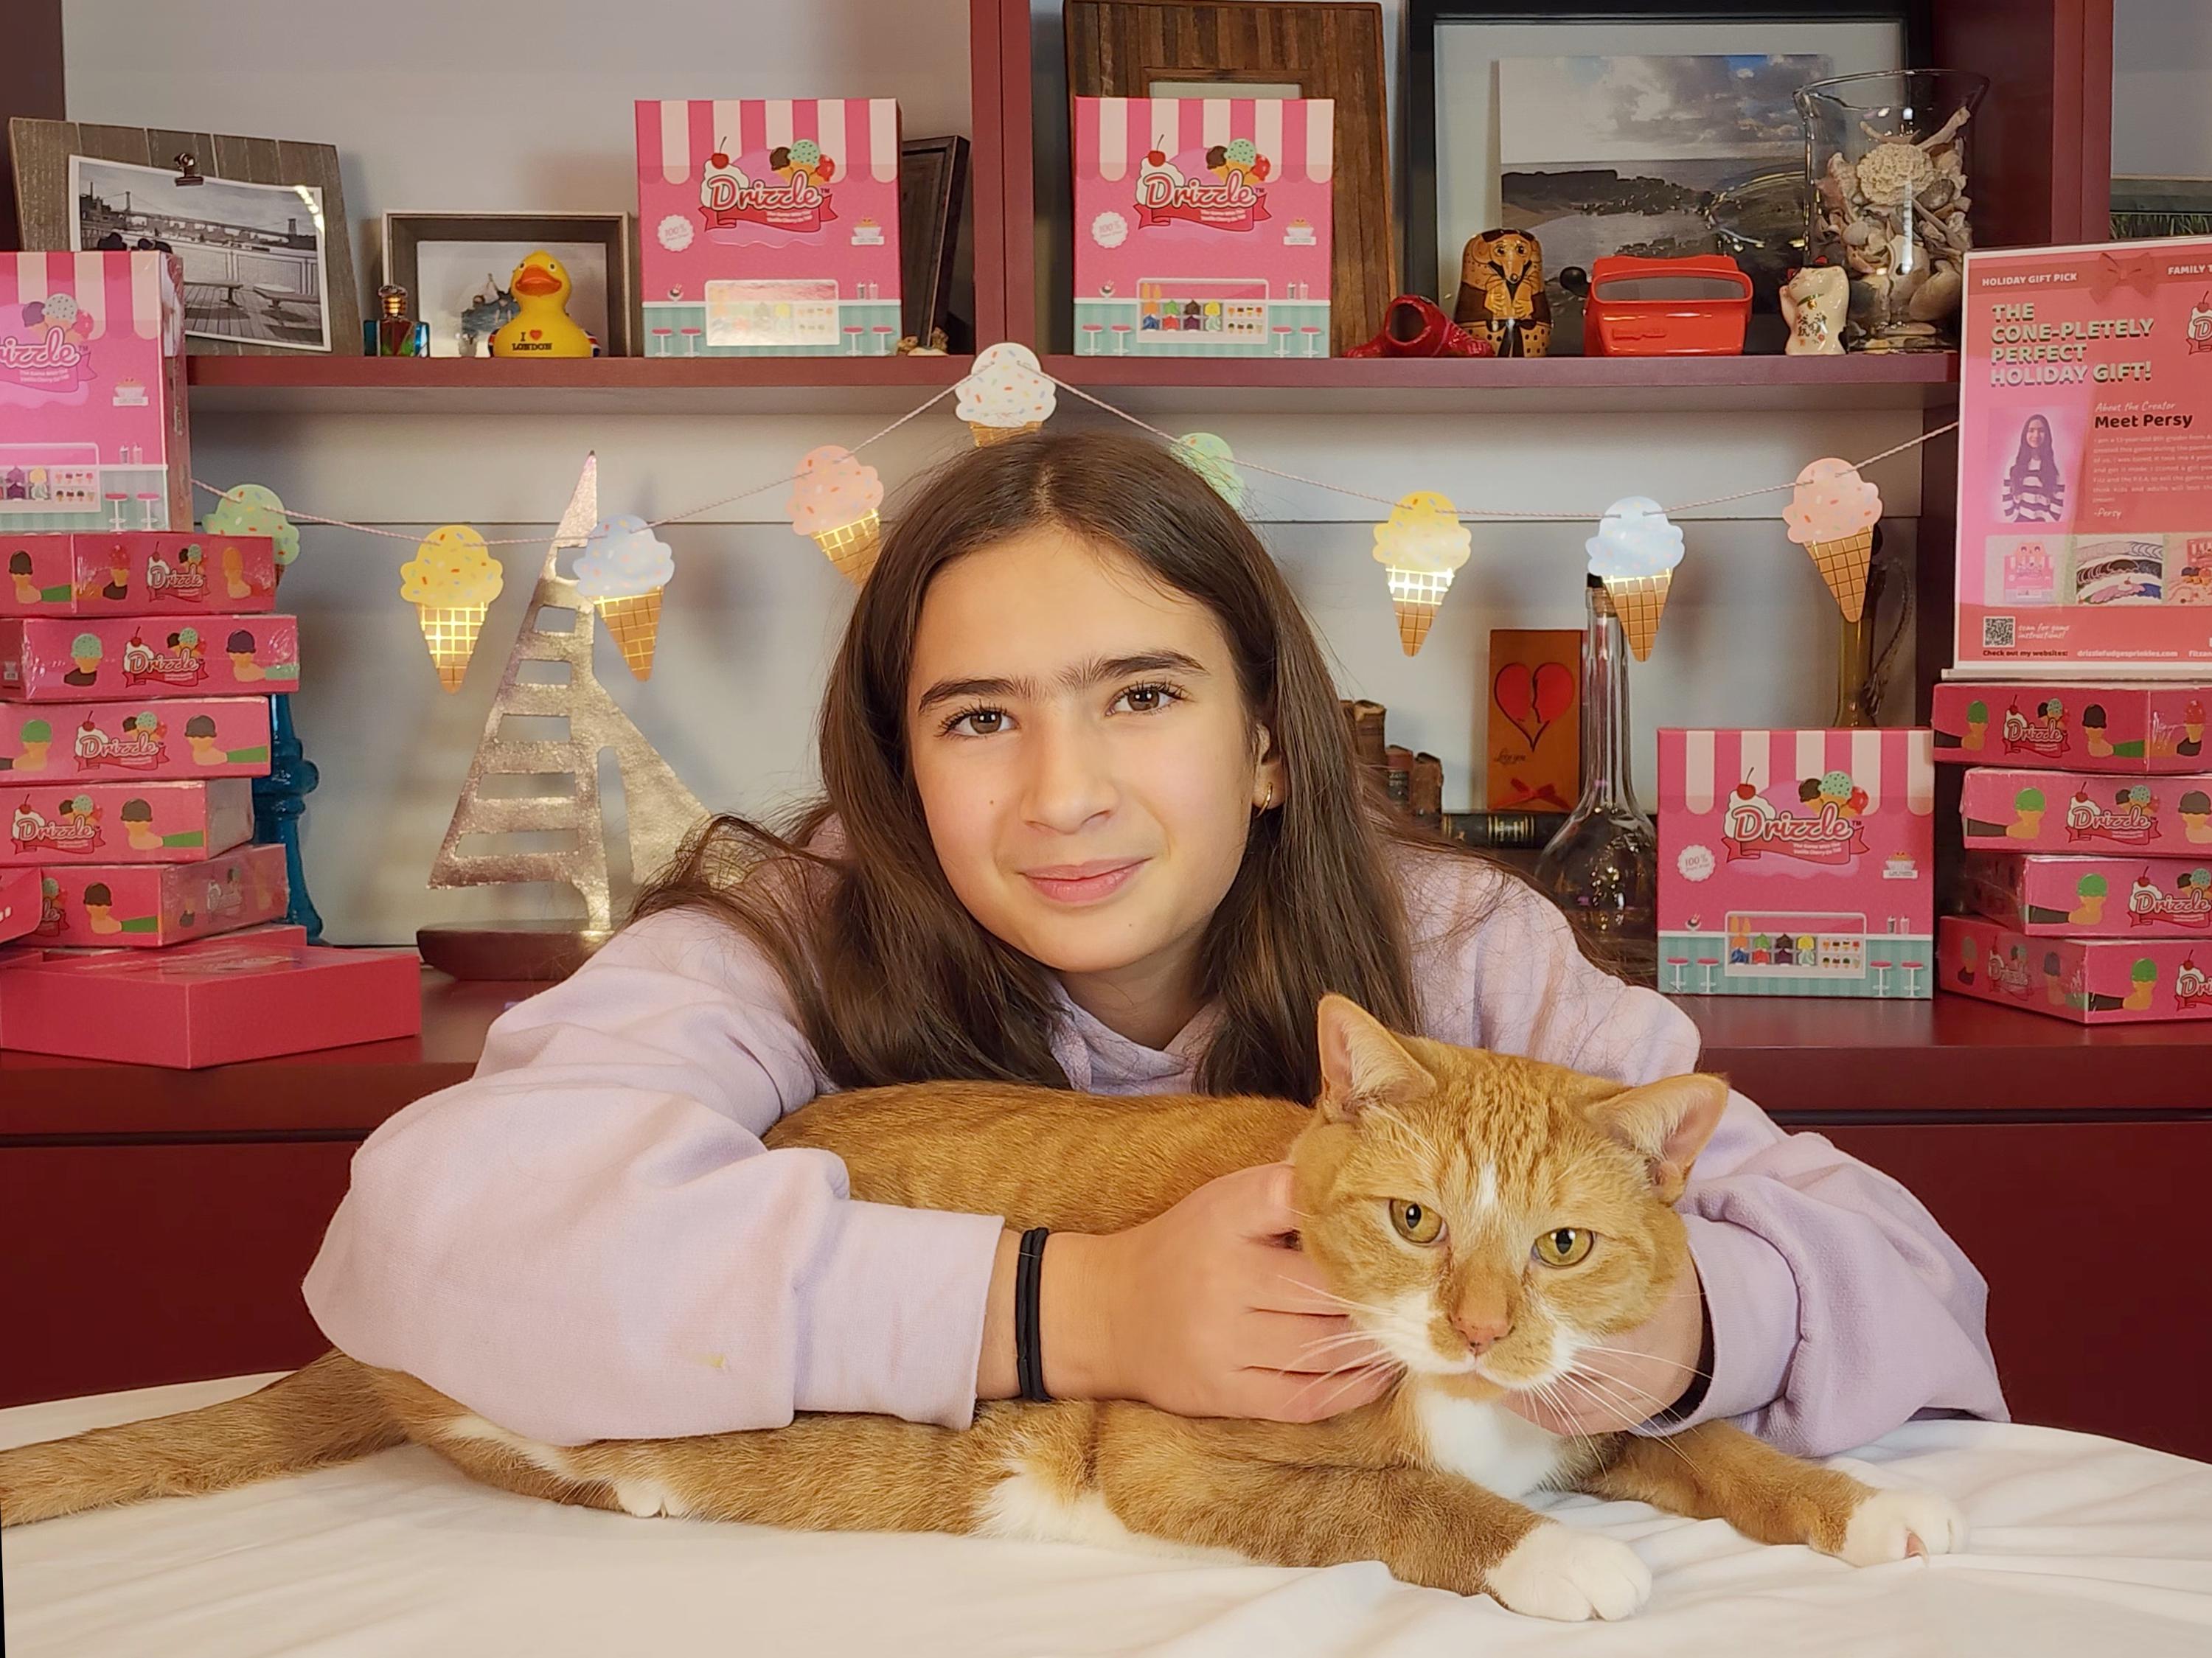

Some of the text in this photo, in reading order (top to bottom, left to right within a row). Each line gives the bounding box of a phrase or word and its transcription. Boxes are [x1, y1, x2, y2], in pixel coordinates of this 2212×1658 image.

[708, 170, 823, 210] Drizzle
[1144, 169, 1258, 209] Drizzle
[1982, 272, 2077, 287] HOLIDAY GIFT PICK
[2168, 264, 2205, 275] FAMILY
[1992, 302, 2034, 322] THE
[520, 331, 526, 342] I
[1991, 318, 2154, 344] CONE-PLETELY
[512, 342, 553, 351] LONDON
[1991, 343, 2087, 366] PERFECT
[1991, 360, 2152, 387] HOLIDAY GIFT!
[2095, 400, 2176, 413] About the Creator
[2095, 414, 2193, 428] Meet Persy
[150, 562, 204, 589] Drizzle
[128, 647, 200, 675] Drizzle
[2007, 717, 2064, 743] Drizzle
[79, 731, 160, 759] Drizzle
[17, 814, 96, 841] Drizzle
[1731, 801, 1854, 842] Drizzle
[2072, 804, 2152, 831] Drizzle
[2135, 888, 2212, 914] Drizzle
